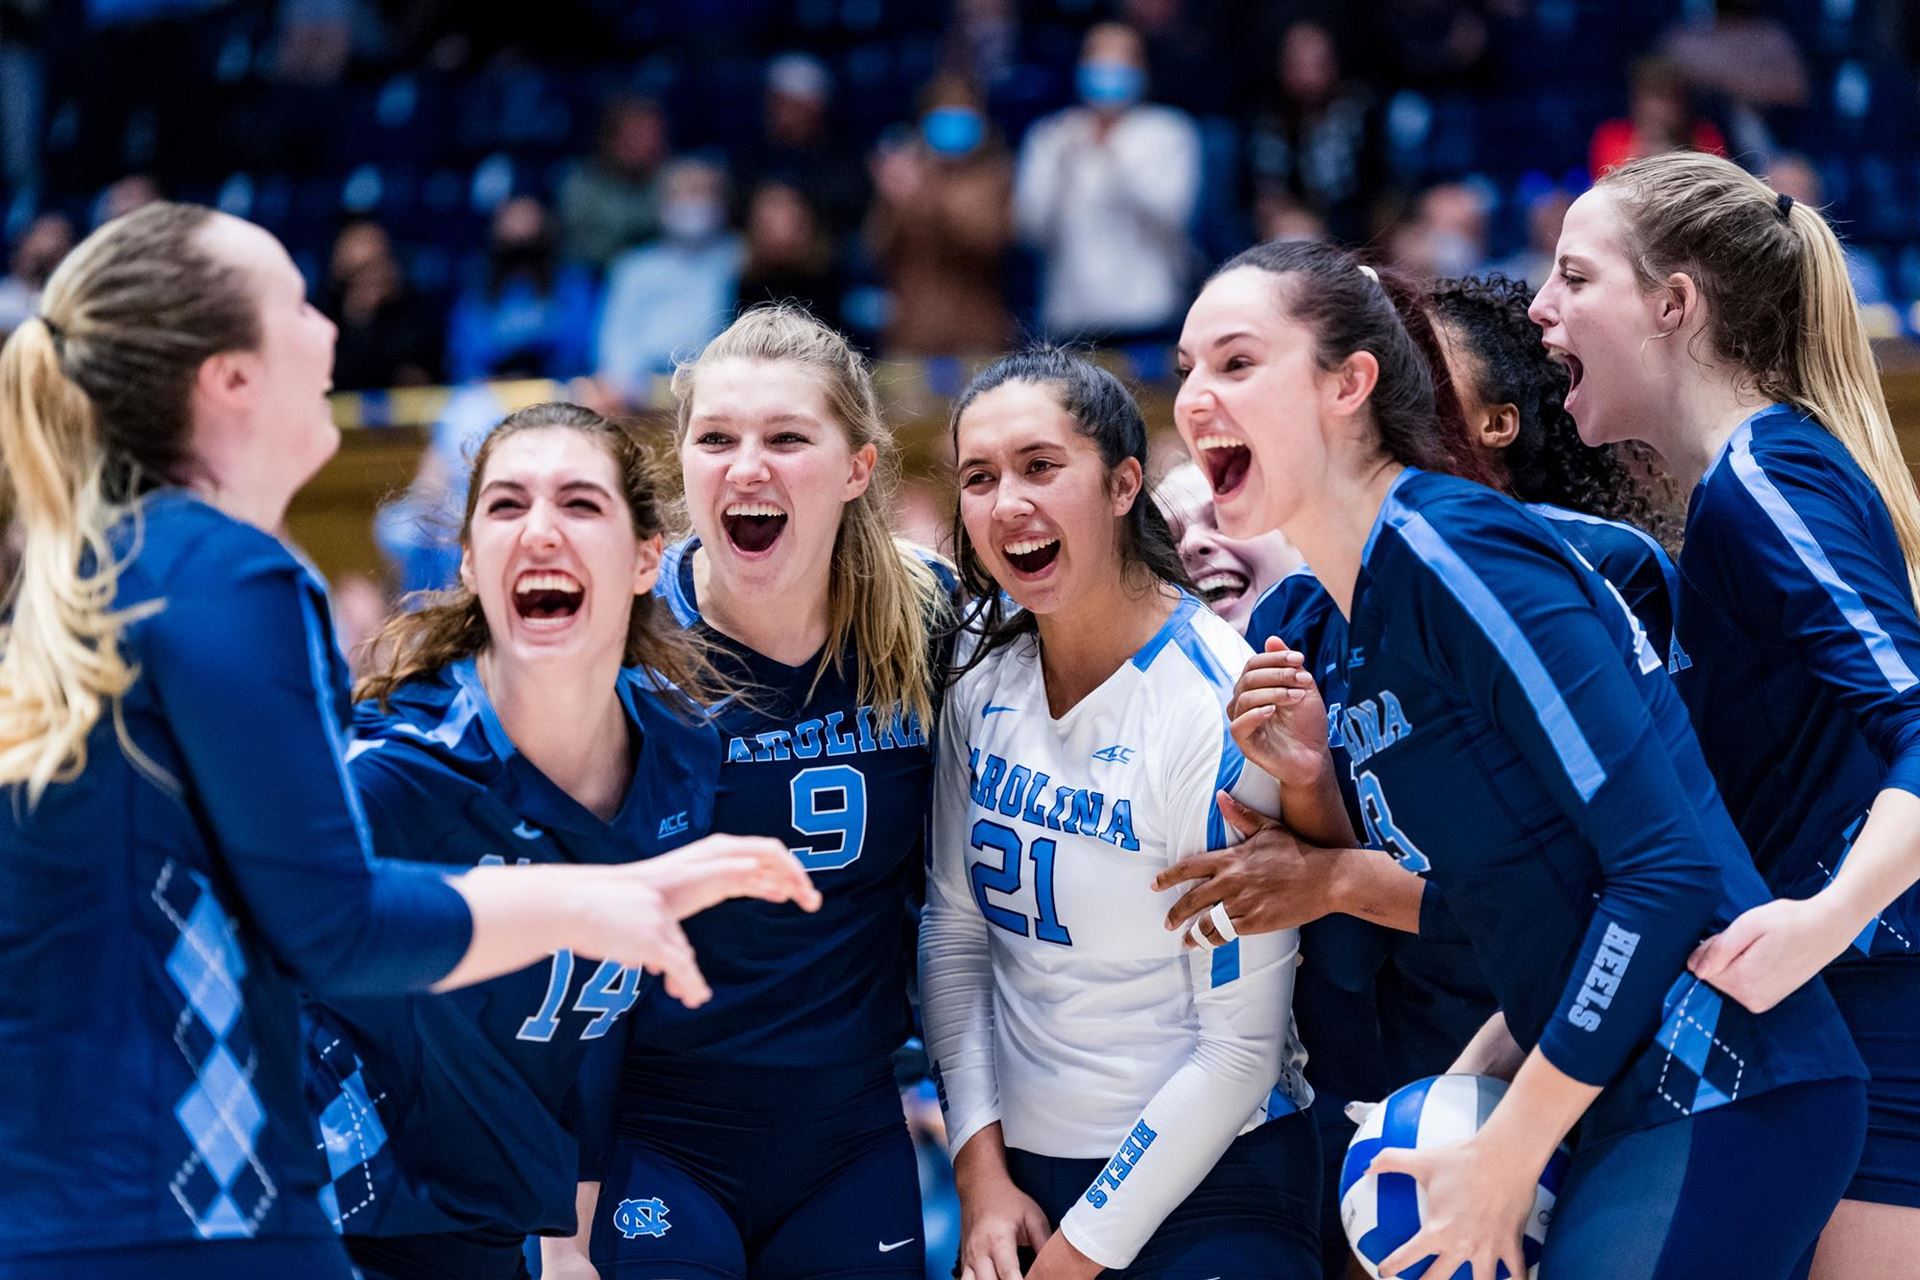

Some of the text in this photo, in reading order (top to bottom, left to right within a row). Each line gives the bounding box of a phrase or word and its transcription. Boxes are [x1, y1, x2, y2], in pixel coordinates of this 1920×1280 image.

[657, 810, 689, 838] ACC
[789, 764, 867, 872] 9
[971, 818, 1073, 946] 21
[515, 948, 642, 1042] 14
[1567, 921, 1641, 1032] HEELS
[1085, 1118, 1158, 1209] HEELS
